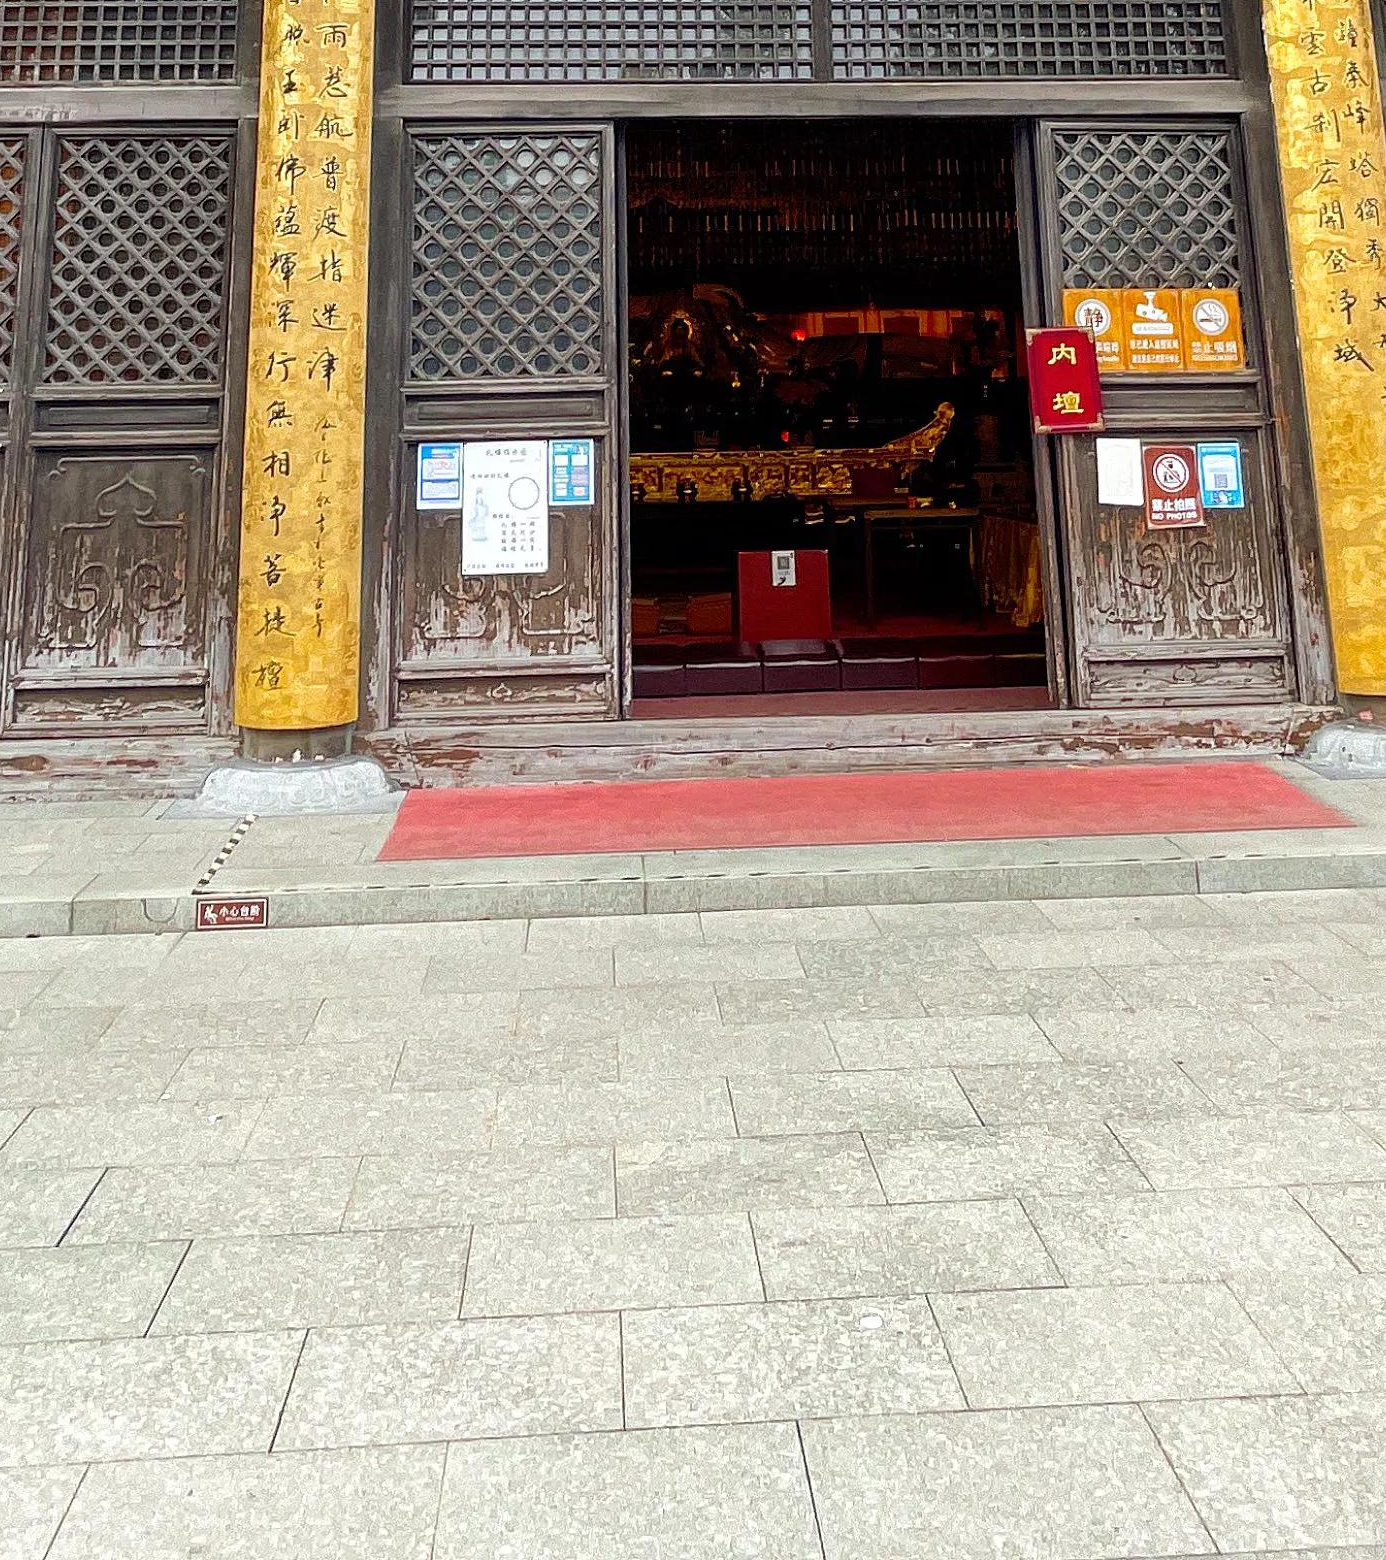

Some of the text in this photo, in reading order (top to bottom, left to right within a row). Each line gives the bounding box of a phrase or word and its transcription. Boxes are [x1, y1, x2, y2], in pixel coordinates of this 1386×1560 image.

[1151, 498, 1196, 512] 禁止拍照
[1151, 511, 1198, 520] NO PHOTOS
[218, 905, 261, 917] 小心台阶
